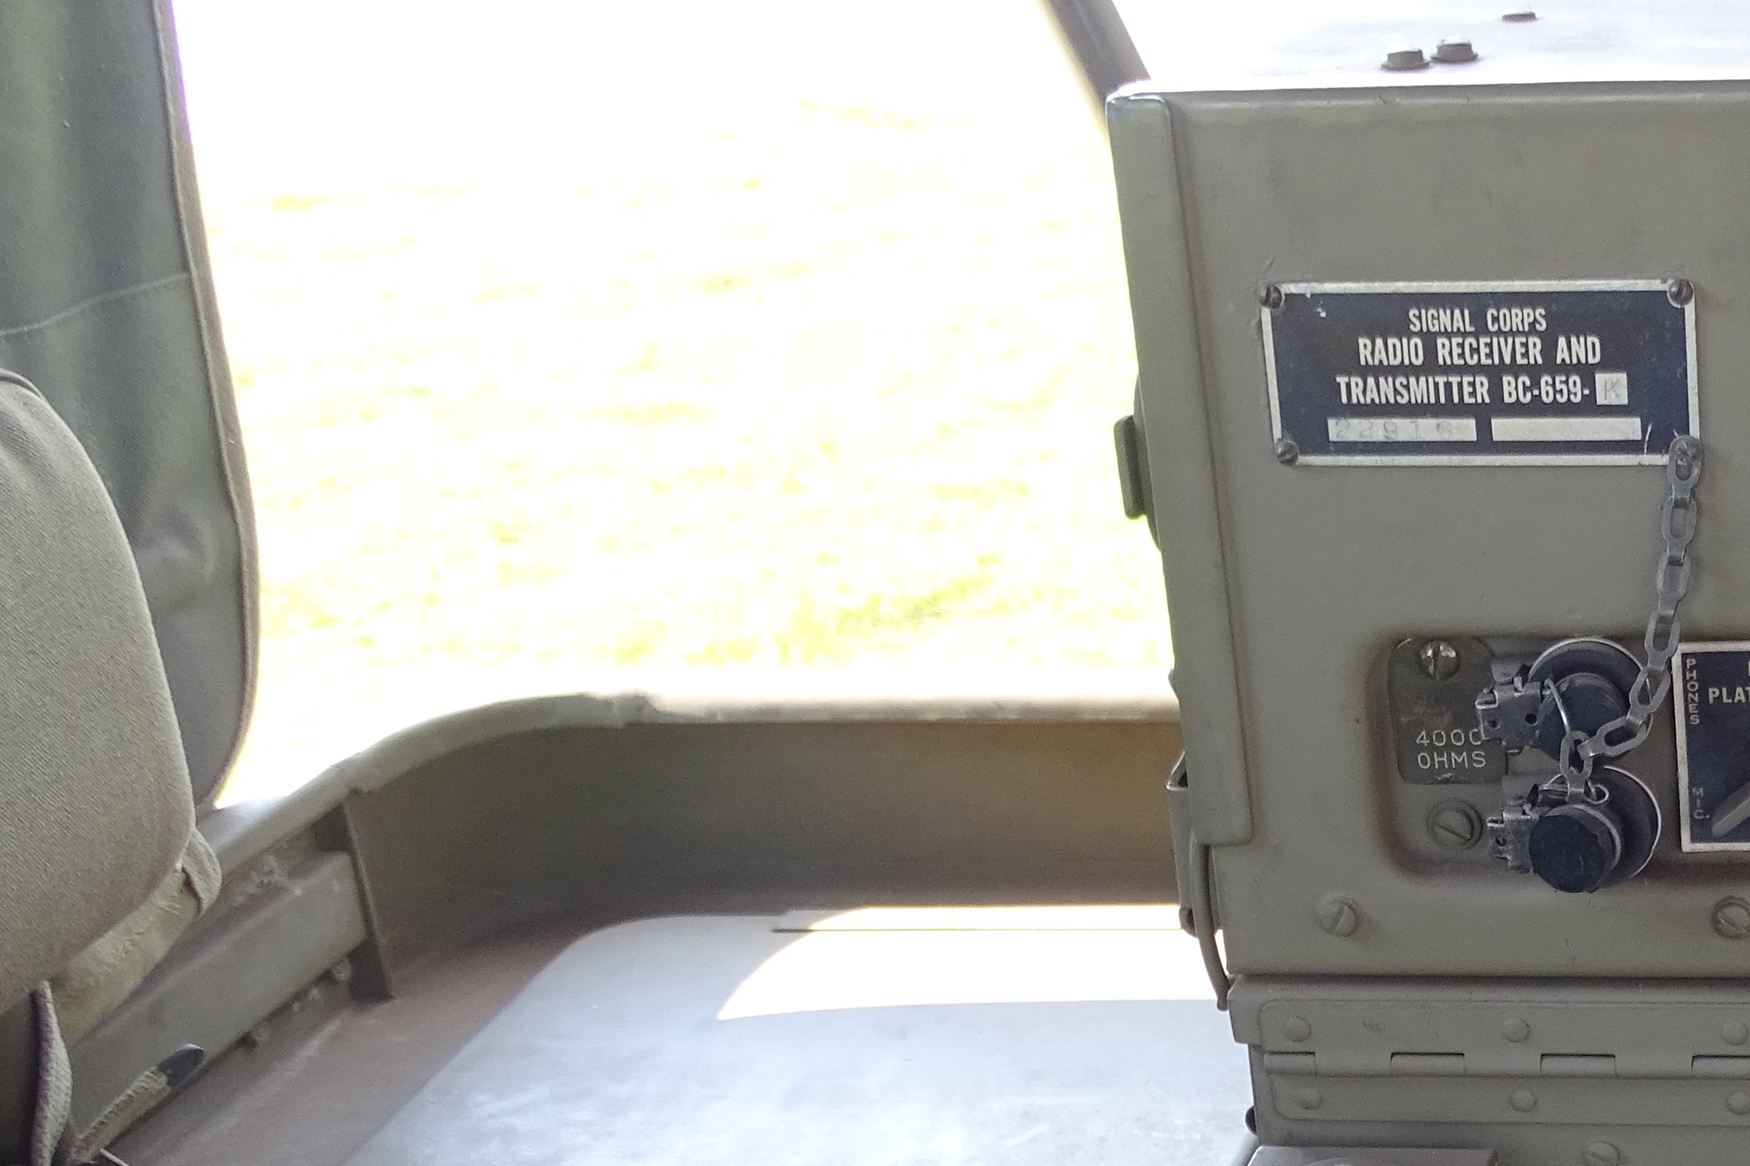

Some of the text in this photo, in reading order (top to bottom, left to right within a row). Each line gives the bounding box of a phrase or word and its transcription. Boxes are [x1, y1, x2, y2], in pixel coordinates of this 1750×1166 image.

[1409, 308, 1547, 332] SIGNAL CORPS
[1358, 336, 1601, 366] RADIO RECEIVER AND
[1336, 375, 1490, 404] TRANSMITTER
[1686, 658, 1700, 726] PHONES
[1417, 751, 1487, 769] OHMS
